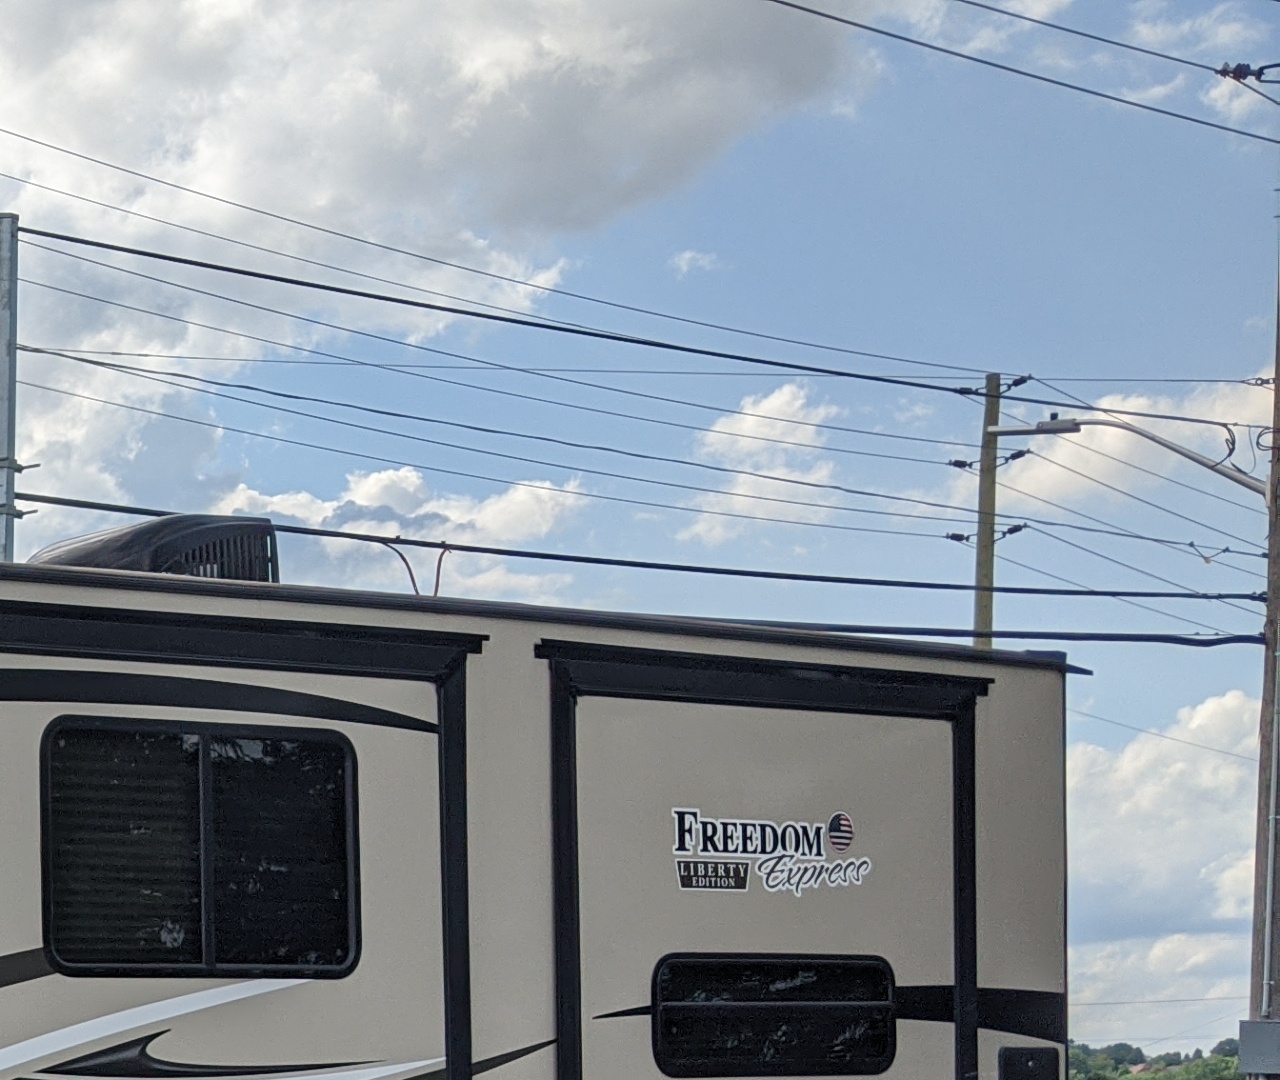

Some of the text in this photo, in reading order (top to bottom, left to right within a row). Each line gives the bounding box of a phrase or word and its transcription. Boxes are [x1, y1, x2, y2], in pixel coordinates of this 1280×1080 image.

[672, 809, 825, 858] FREEDOM
[679, 862, 748, 878] LIBERTY
[691, 876, 736, 888] EDITION
[757, 854, 870, 893] Express
